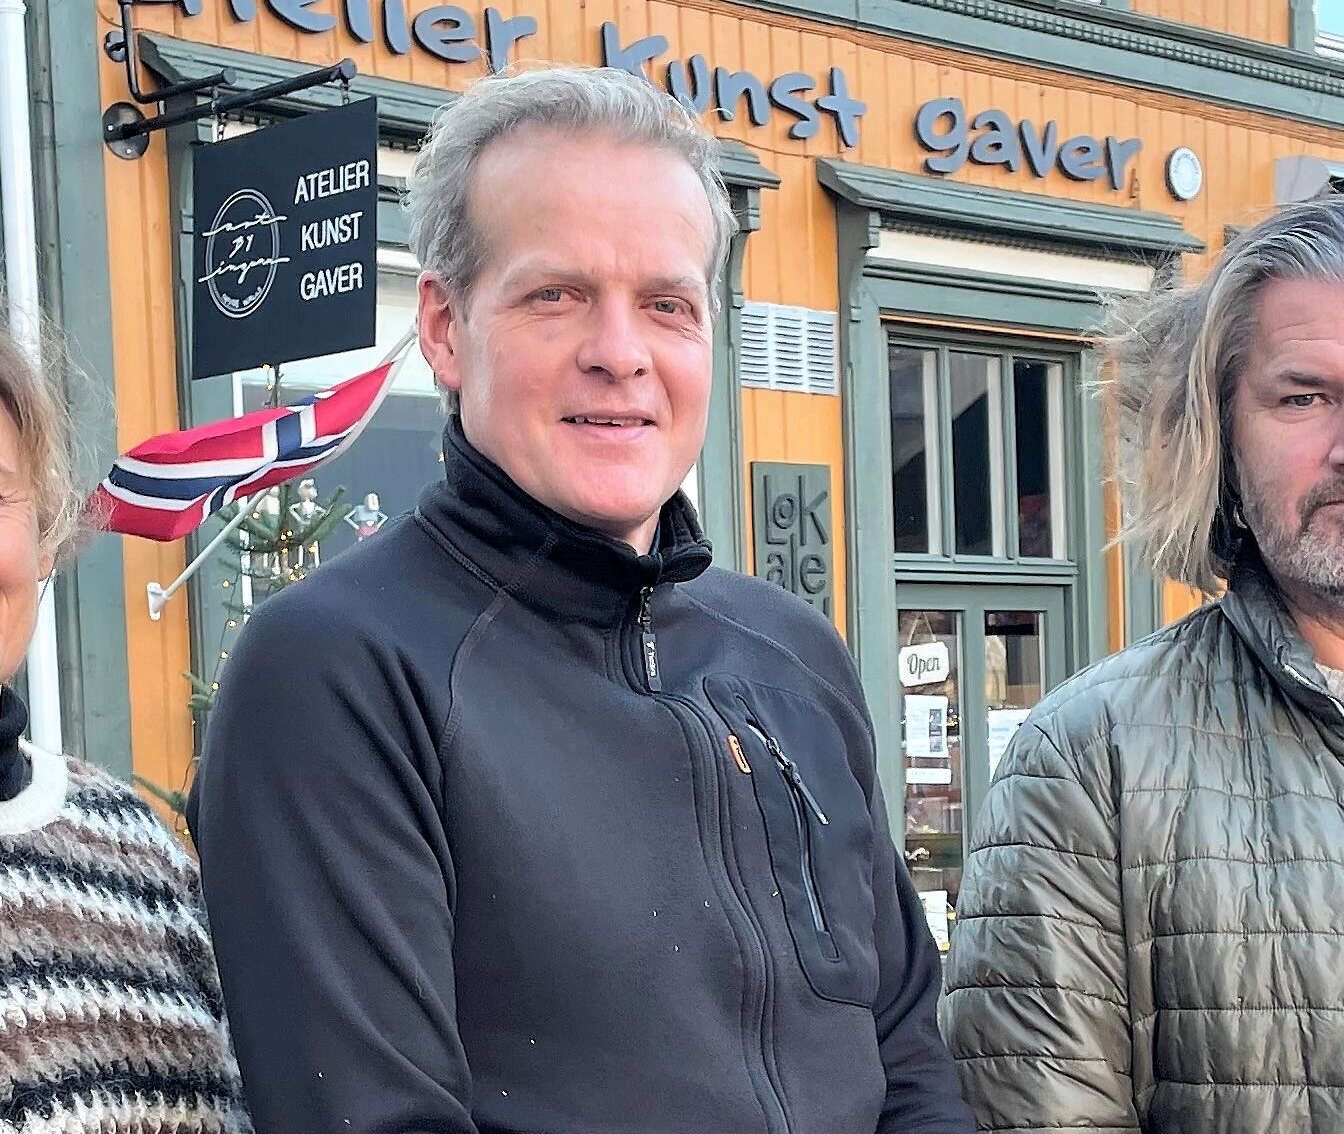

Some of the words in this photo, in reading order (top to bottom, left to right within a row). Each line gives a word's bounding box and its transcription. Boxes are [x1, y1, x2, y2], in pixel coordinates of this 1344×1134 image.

[178, 0, 538, 74] elier
[601, 21, 866, 148] Kunst
[915, 97, 1141, 190] gaver
[294, 159, 370, 205] ATELIER
[300, 211, 363, 252] KUNST
[299, 262, 363, 301] GAVER
[906, 653, 940, 680] Open
